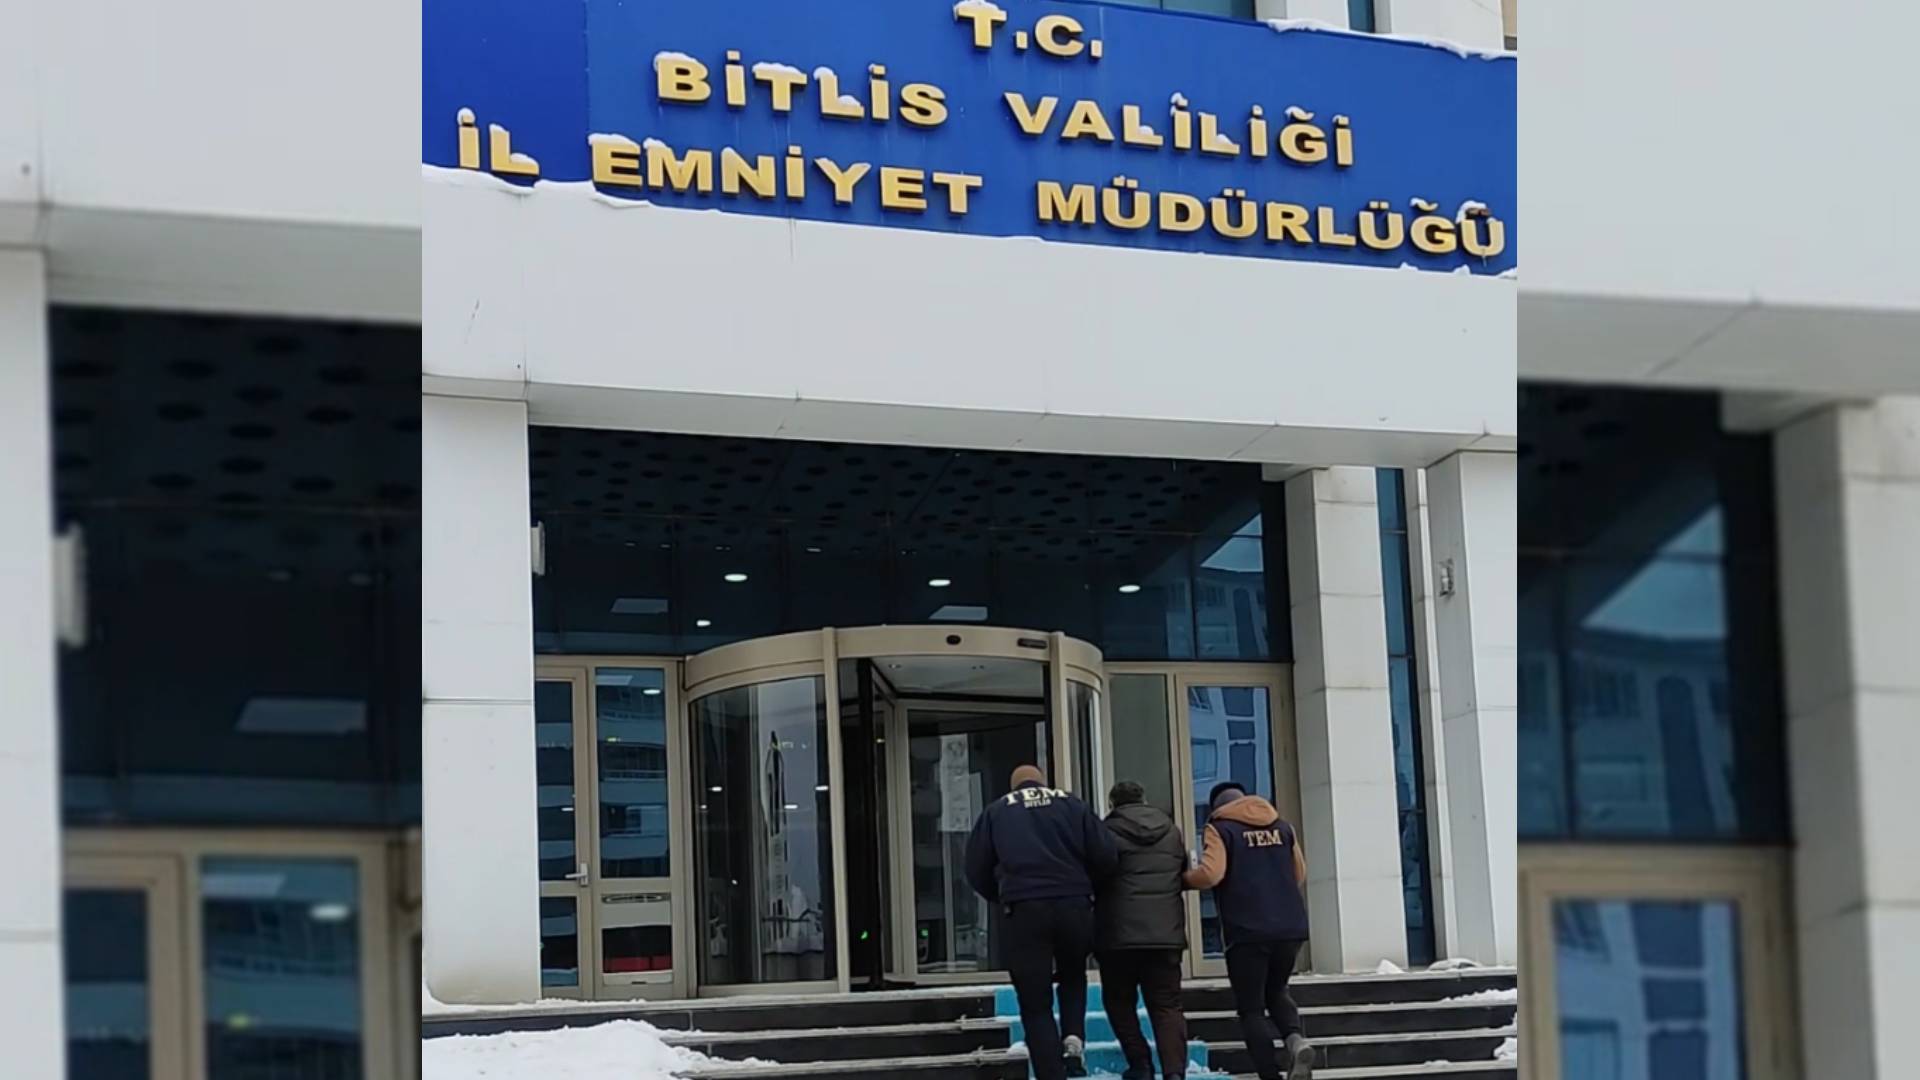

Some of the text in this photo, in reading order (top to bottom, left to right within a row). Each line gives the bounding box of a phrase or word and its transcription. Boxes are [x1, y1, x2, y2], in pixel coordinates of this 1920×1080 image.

[957, 2, 1103, 58] T.C.
[656, 50, 1355, 167] BİTLİS VALİLİĞİ
[458, 109, 1506, 256] İL EMNİYET MÜDÜRLÜĞÜ
[1000, 787, 1070, 806] TEM
[1242, 829, 1283, 847] TEM
